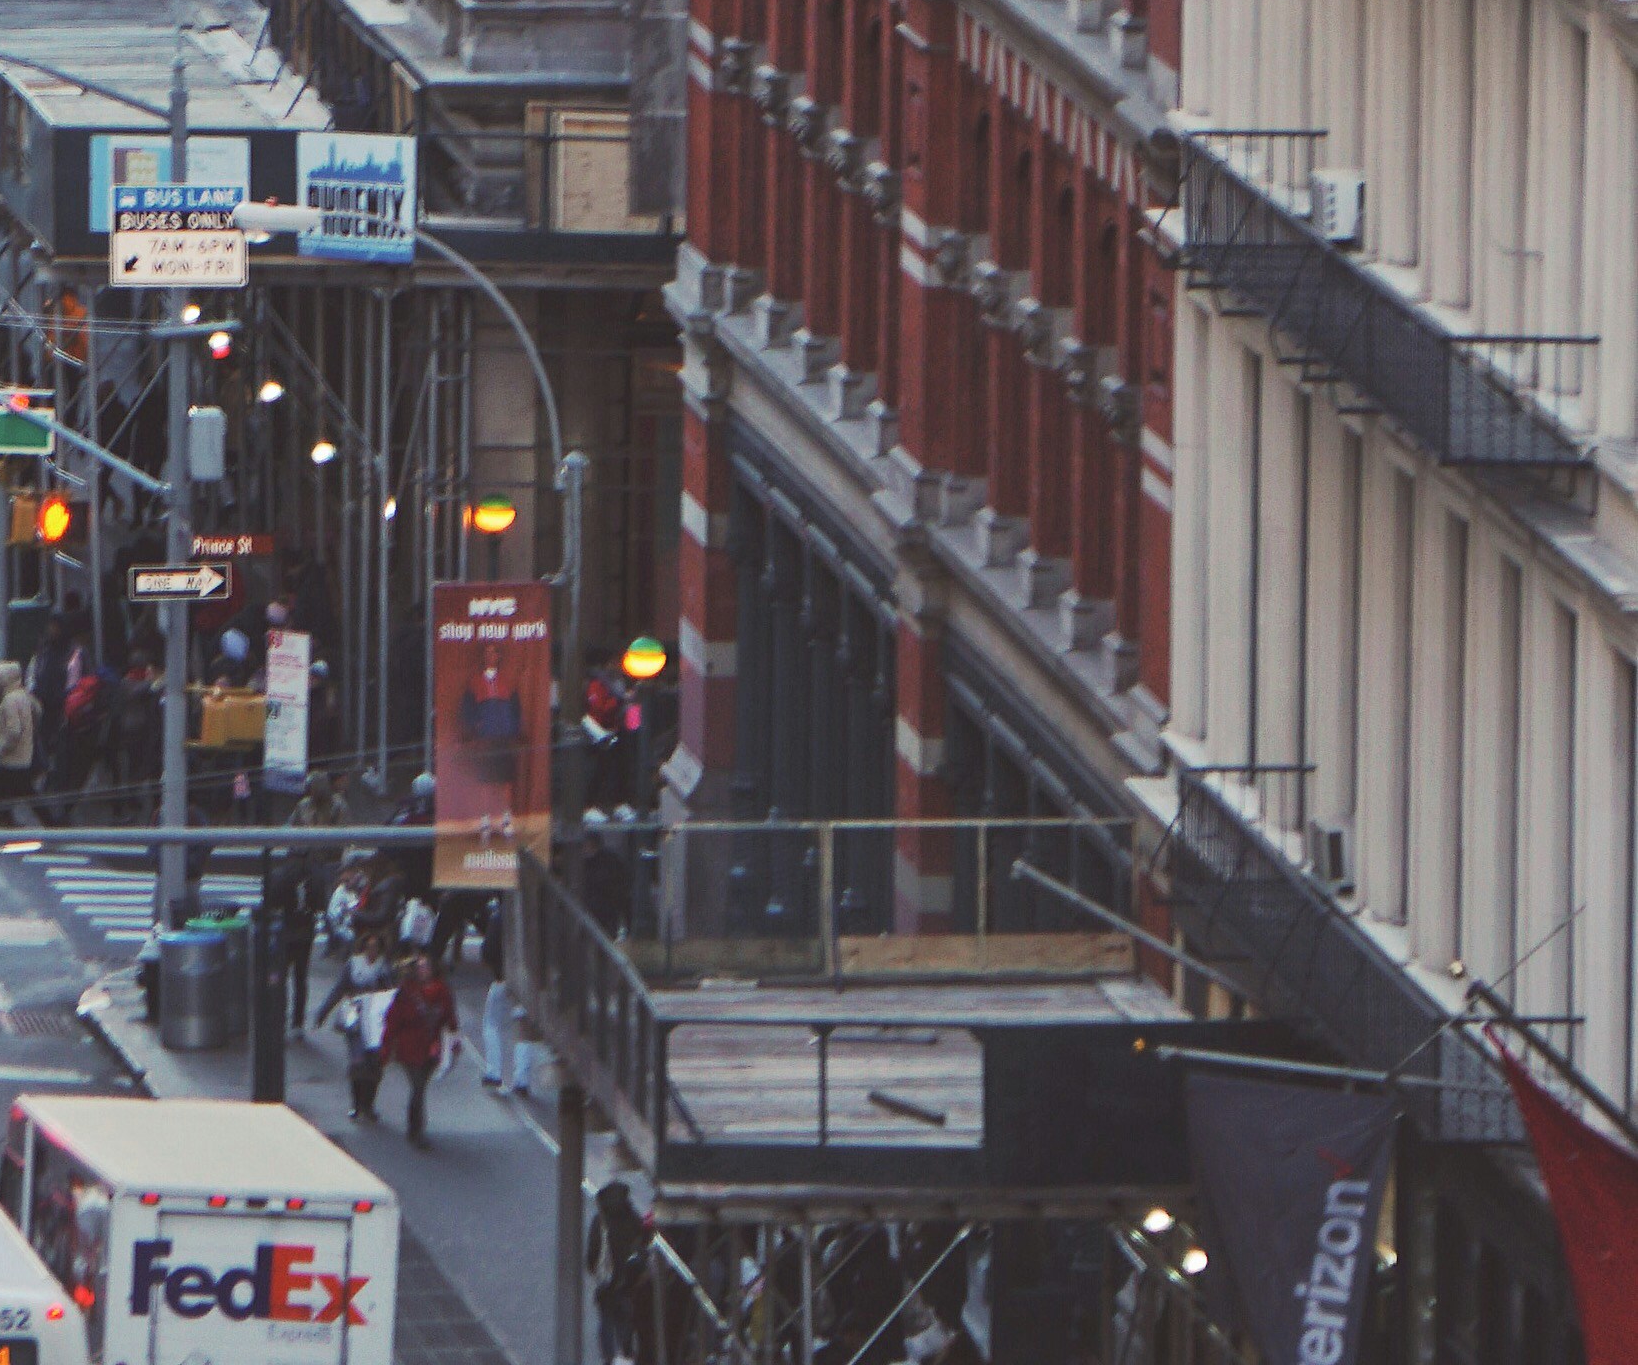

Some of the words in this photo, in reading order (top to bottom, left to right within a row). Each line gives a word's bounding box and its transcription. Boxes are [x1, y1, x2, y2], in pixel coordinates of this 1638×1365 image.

[143, 189, 183, 207] BUS
[187, 189, 235, 208] LANE
[120, 211, 182, 230] BUSES
[186, 212, 234, 230] ONLY
[192, 535, 234, 556] Prince
[130, 1239, 370, 1325] FedEx
